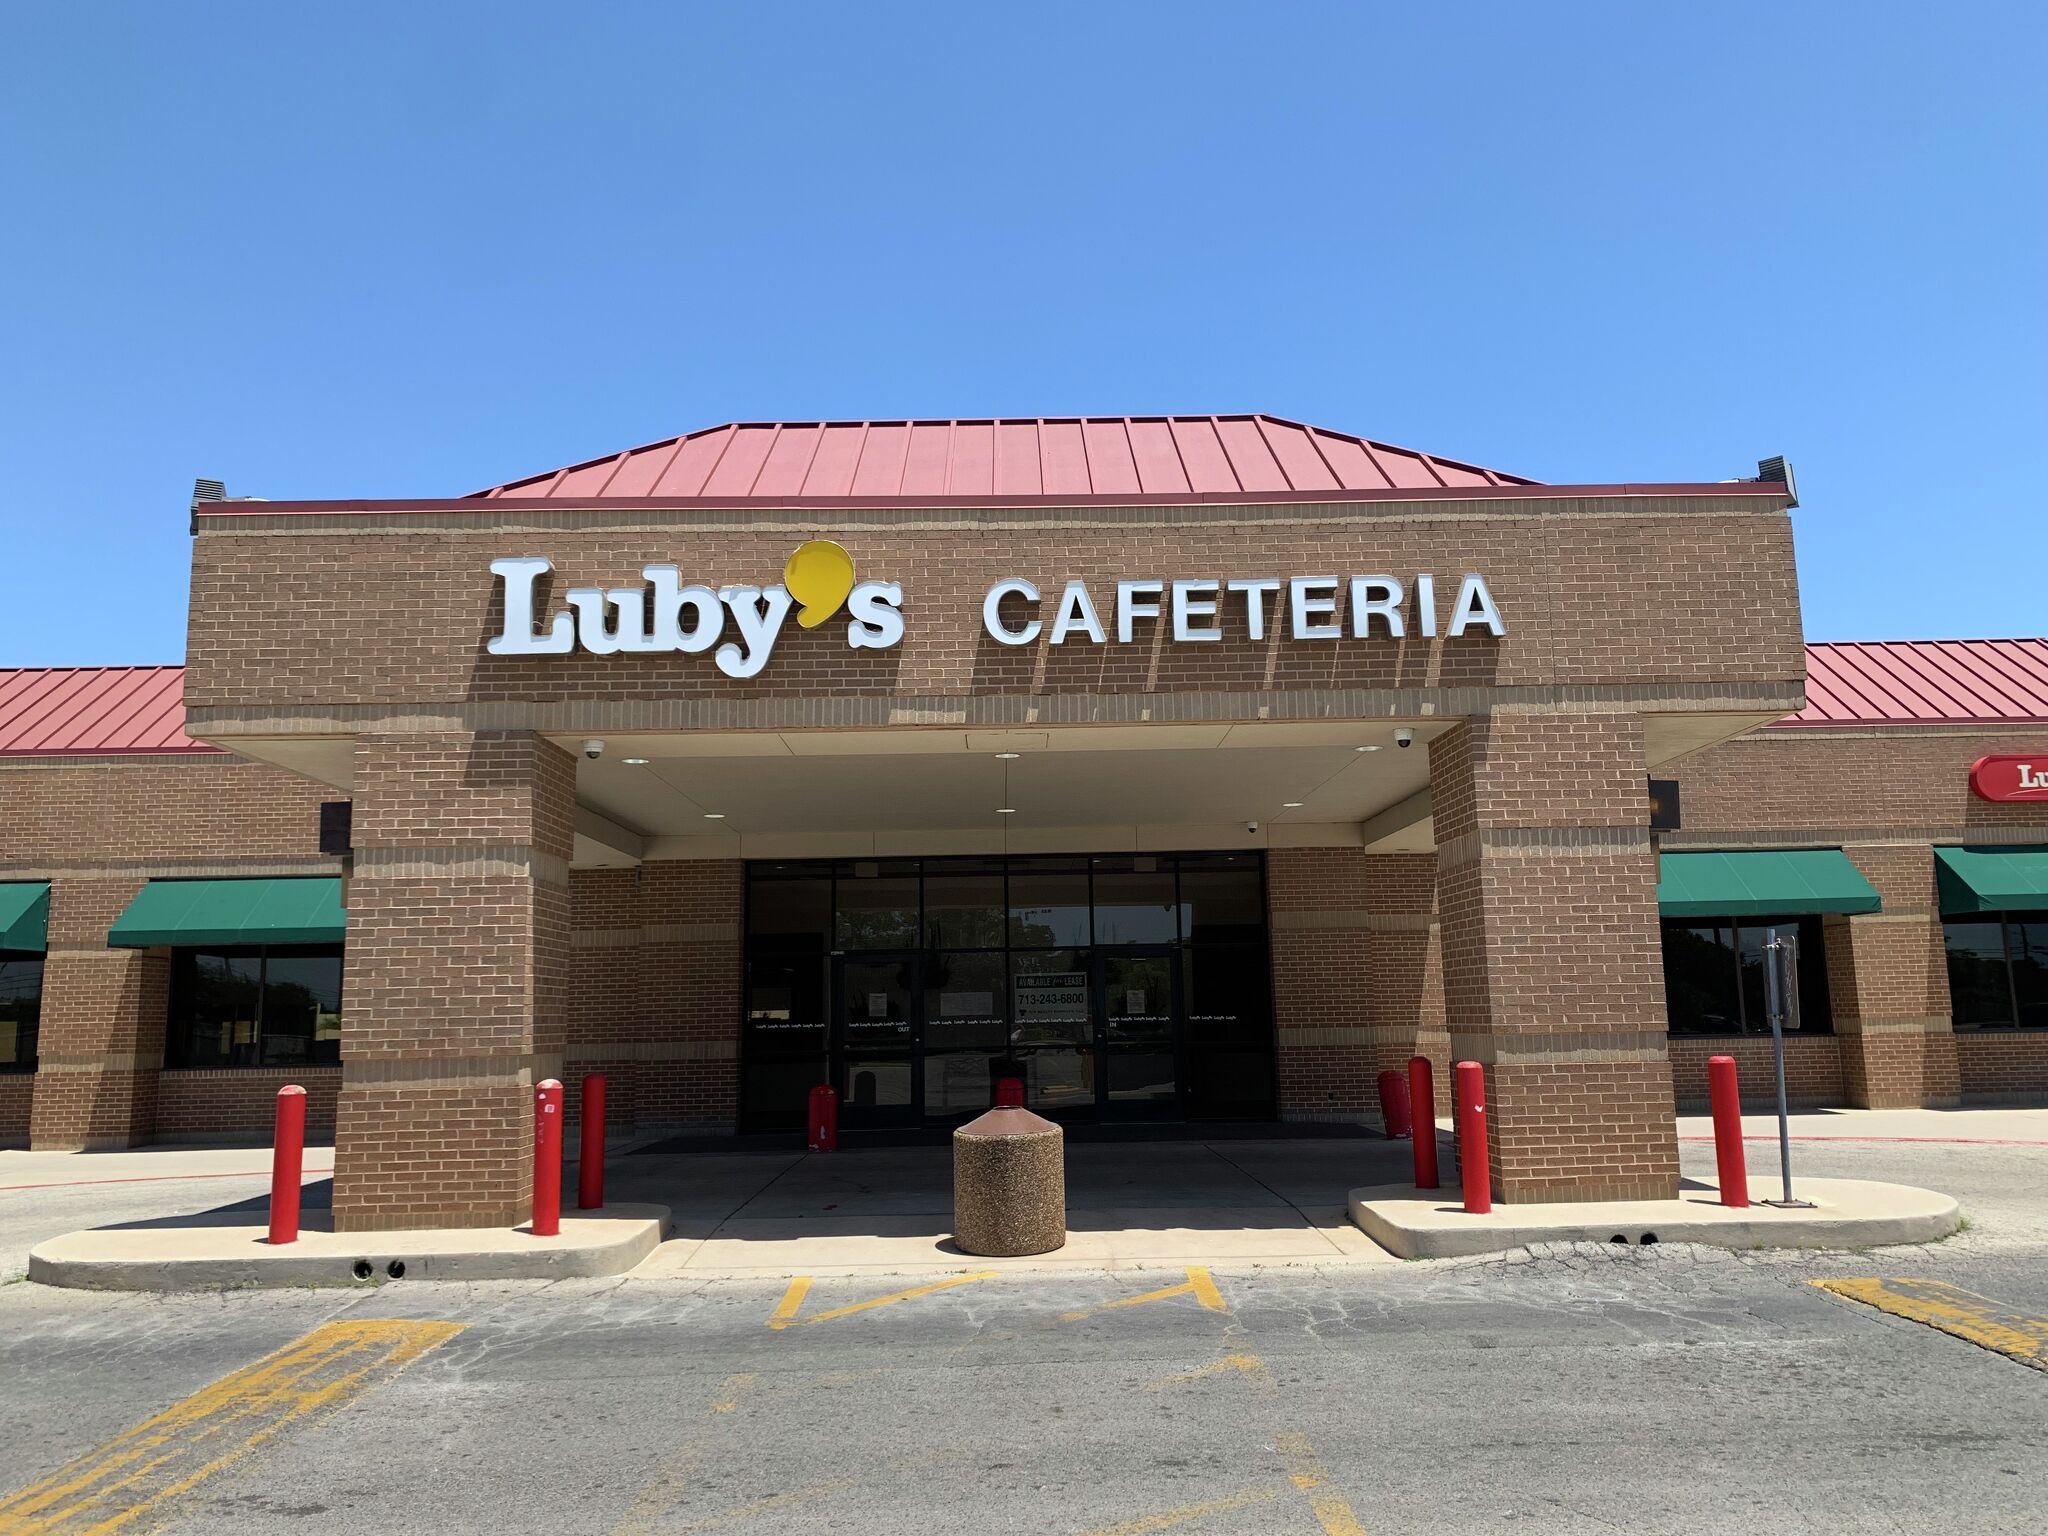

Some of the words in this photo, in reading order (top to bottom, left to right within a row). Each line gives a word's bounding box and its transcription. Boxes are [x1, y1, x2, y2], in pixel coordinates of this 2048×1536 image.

[486, 540, 905, 680] Luby's
[981, 573, 1506, 648] CAFETERIA
[1017, 993, 1084, 1005] 713-243-6800
